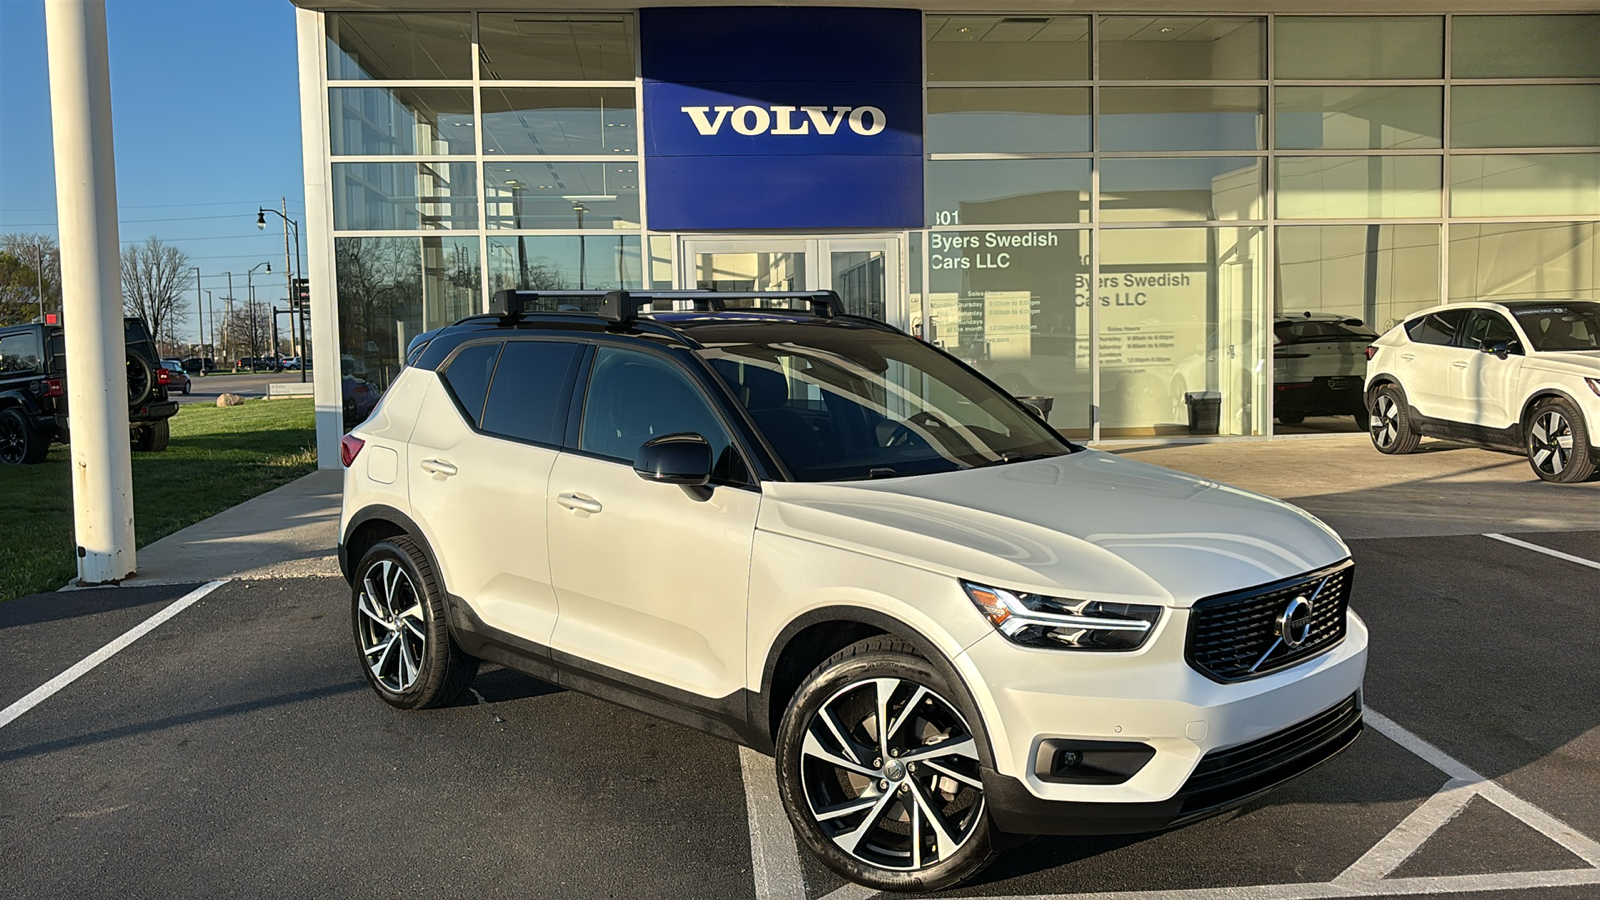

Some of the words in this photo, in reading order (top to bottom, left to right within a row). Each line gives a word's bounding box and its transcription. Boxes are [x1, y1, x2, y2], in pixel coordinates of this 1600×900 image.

[681, 105, 886, 136] VOLVO
[932, 233, 980, 252] Byers
[985, 231, 1058, 248] Swedish
[932, 253, 971, 269] Cars
[976, 252, 1010, 268] LLC
[1124, 273, 1190, 287] Swedish
[1116, 292, 1147, 306] LLC
